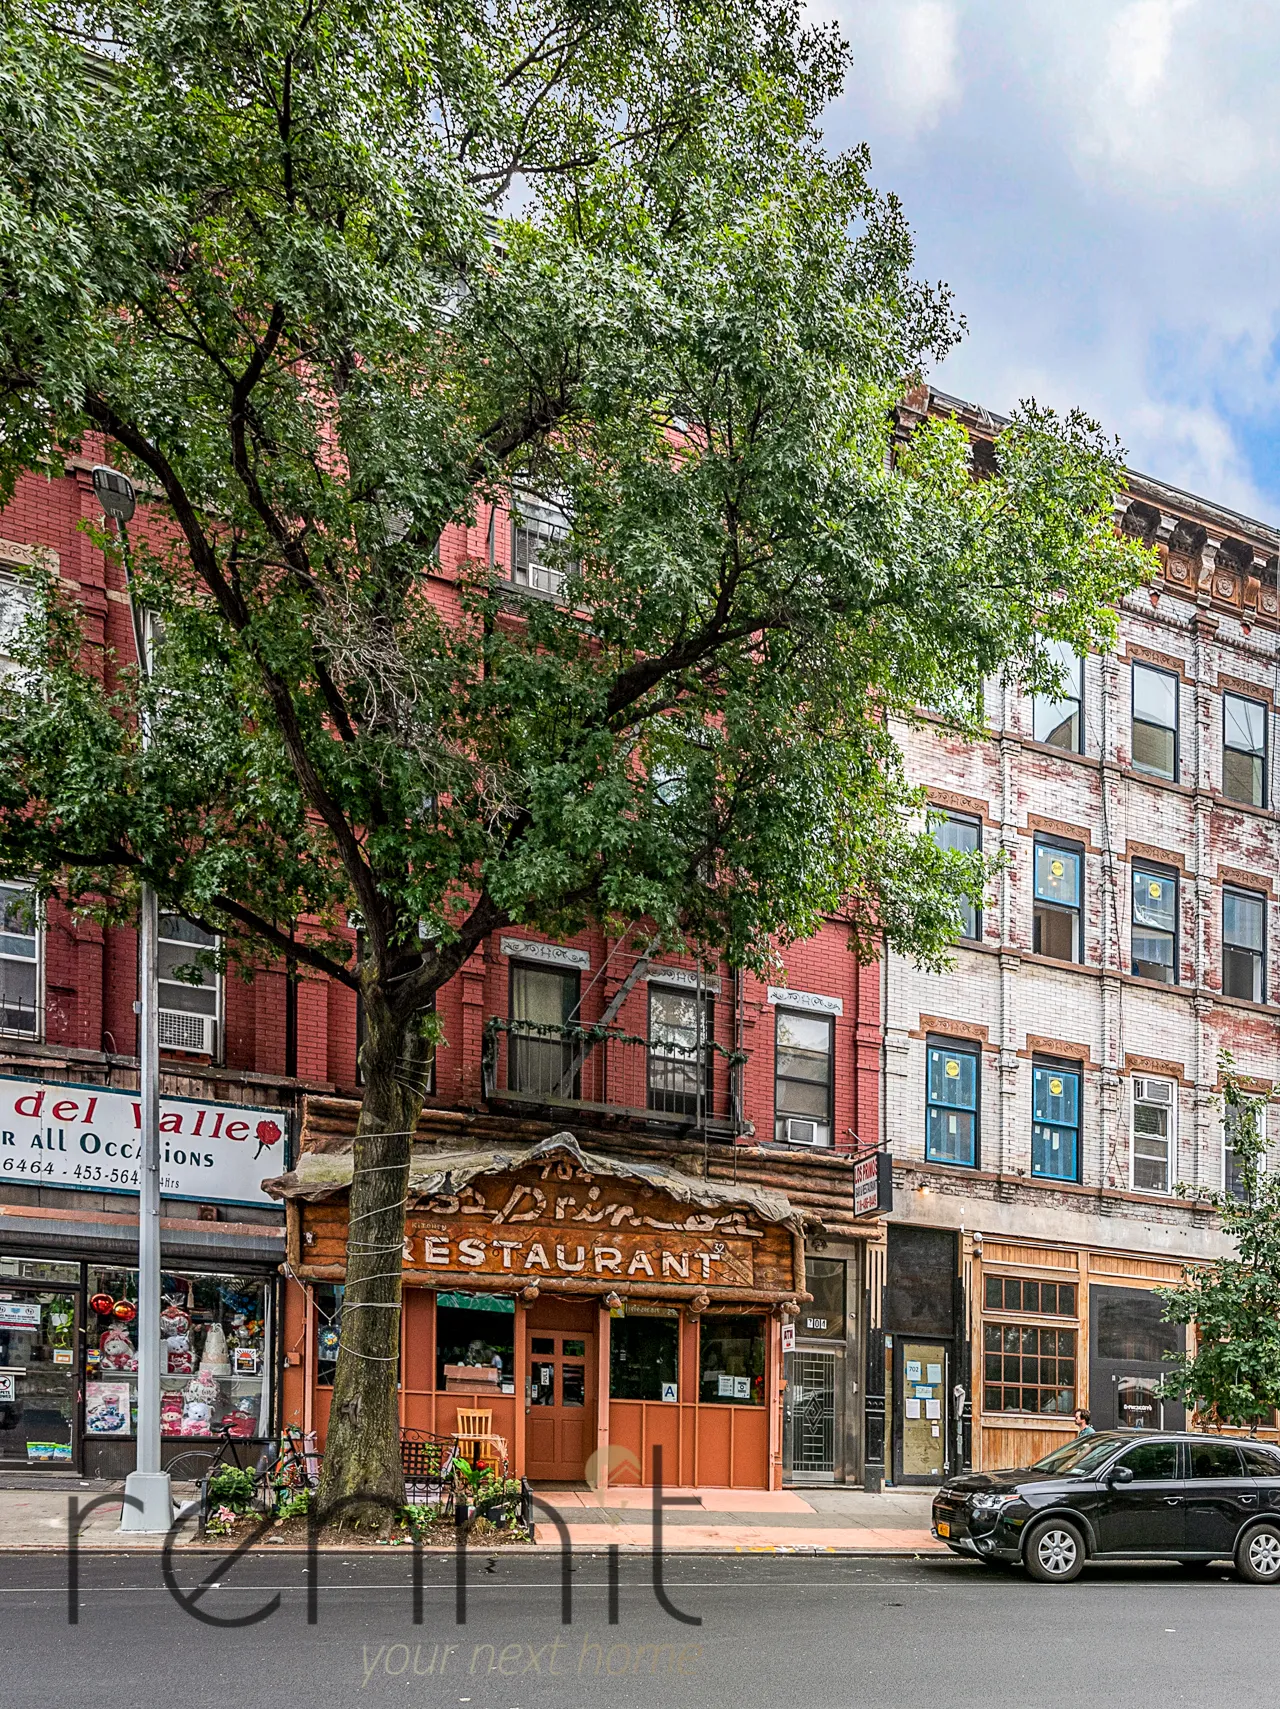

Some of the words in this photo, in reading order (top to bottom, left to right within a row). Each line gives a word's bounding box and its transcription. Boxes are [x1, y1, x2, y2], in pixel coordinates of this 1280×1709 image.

[14, 1091, 98, 1124] del
[74, 1164, 142, 1186] 453-564
[537, 1161, 595, 1183] 704
[402, 1236, 721, 1279] RESTAURANT
[714, 1243, 725, 1254] 32
